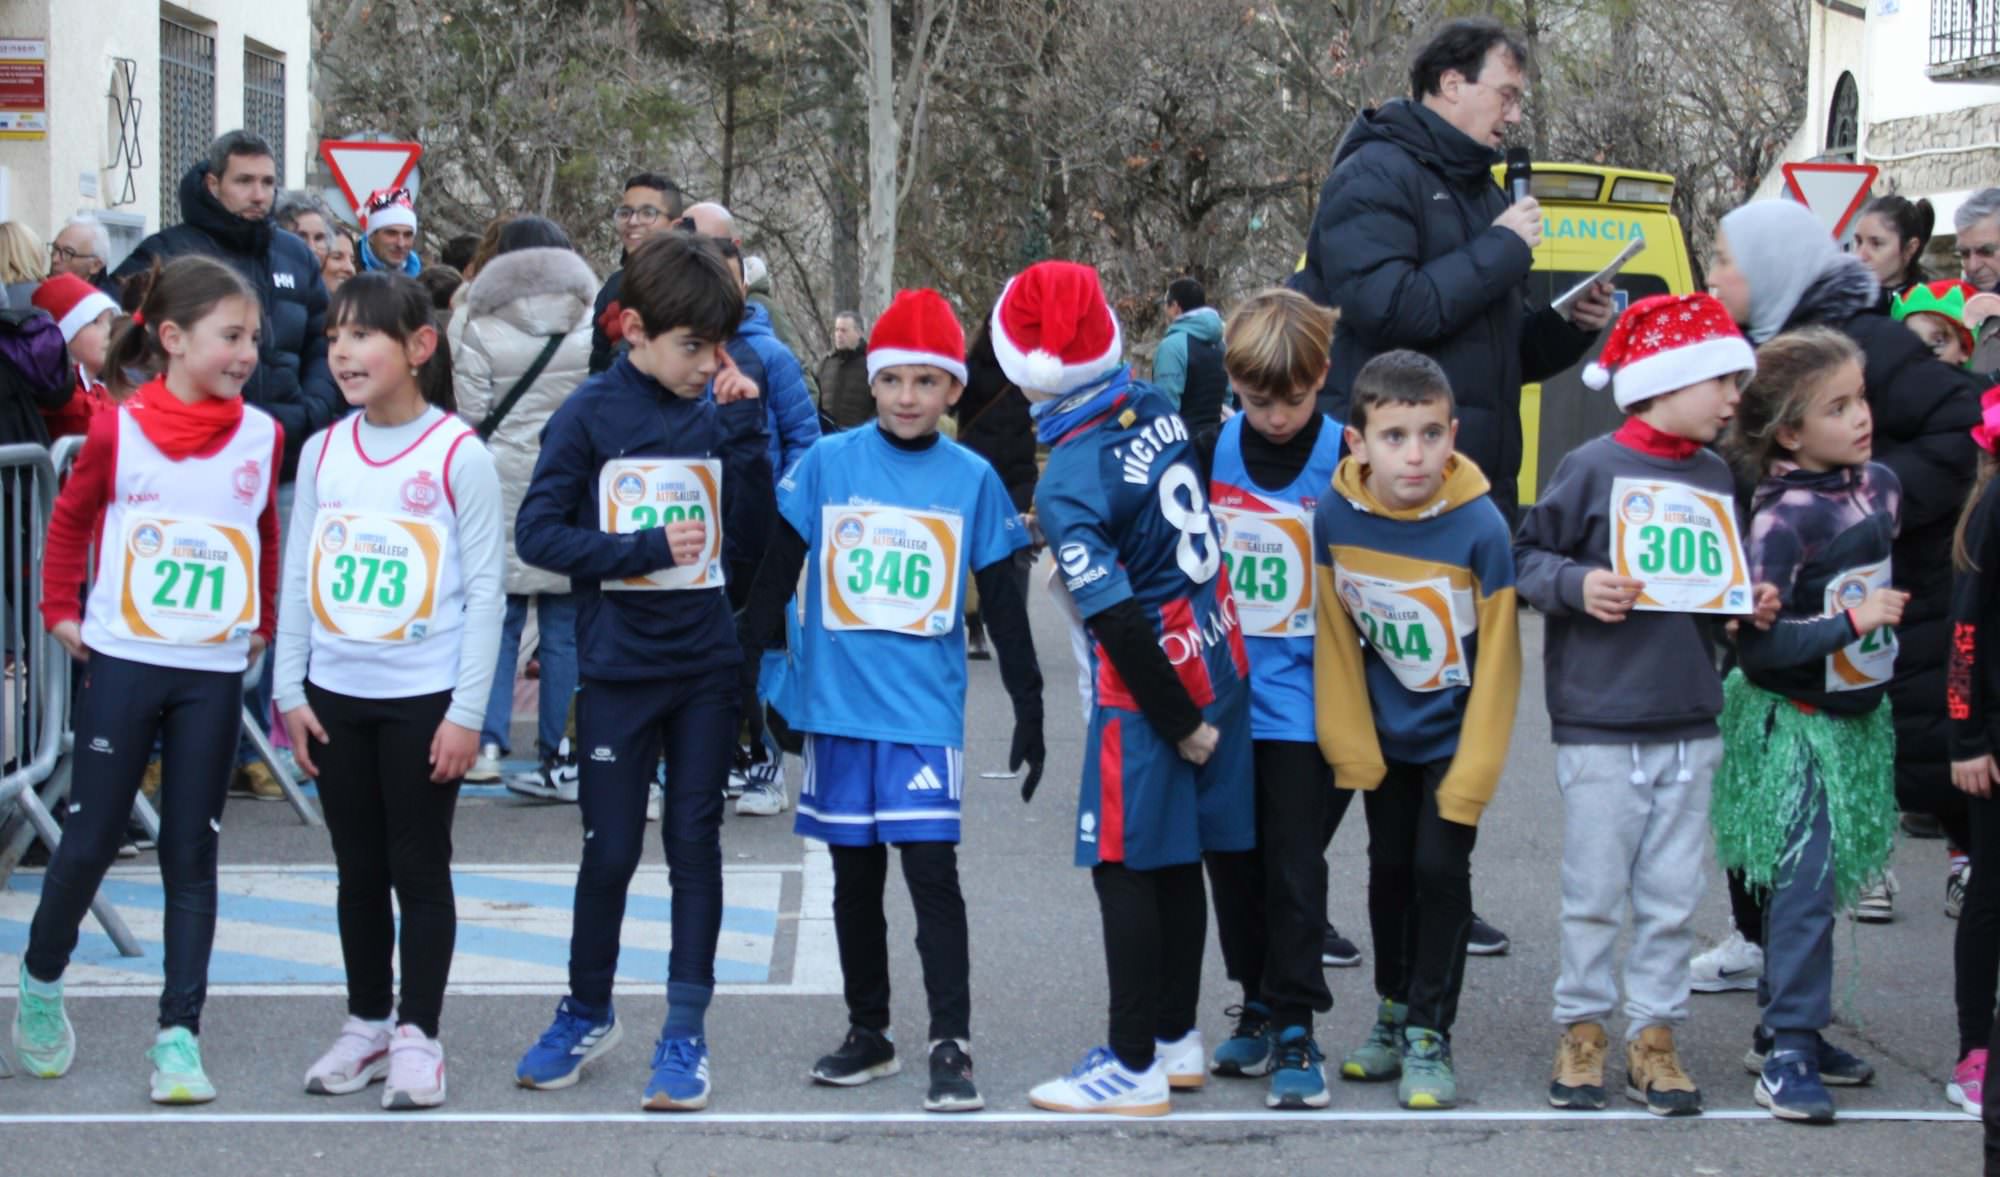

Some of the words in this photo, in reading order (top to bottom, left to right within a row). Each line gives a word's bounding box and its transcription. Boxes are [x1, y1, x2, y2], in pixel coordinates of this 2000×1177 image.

[1158, 463, 1221, 584] 8
[847, 547, 932, 600] 346
[1638, 524, 1723, 577] 306
[152, 559, 226, 612] 271
[331, 554, 408, 608] 373
[1360, 611, 1433, 662] 244
